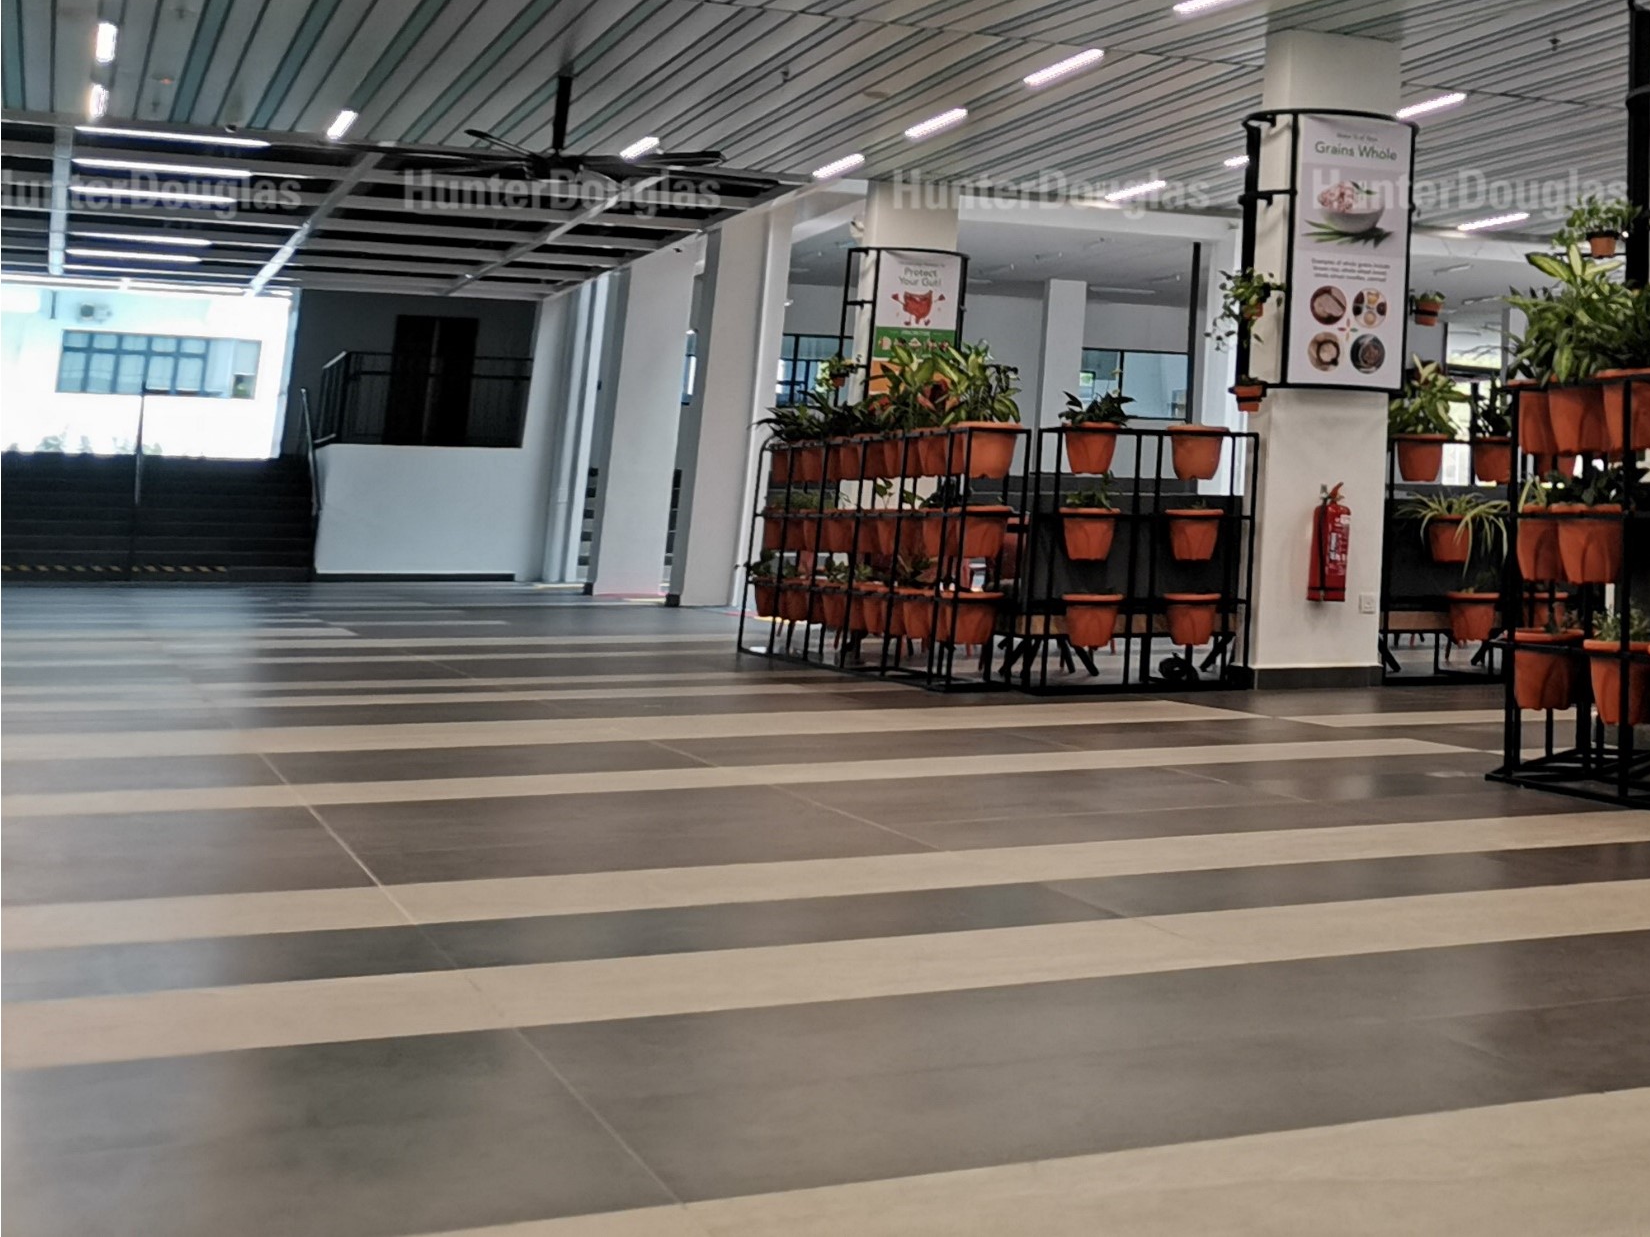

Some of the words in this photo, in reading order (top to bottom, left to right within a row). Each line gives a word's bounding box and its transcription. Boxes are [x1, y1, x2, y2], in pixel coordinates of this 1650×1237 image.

[1315, 141, 1355, 157] Grains
[1358, 145, 1398, 161] Whole
[904, 266, 938, 278] Protect
[898, 276, 919, 286] Your
